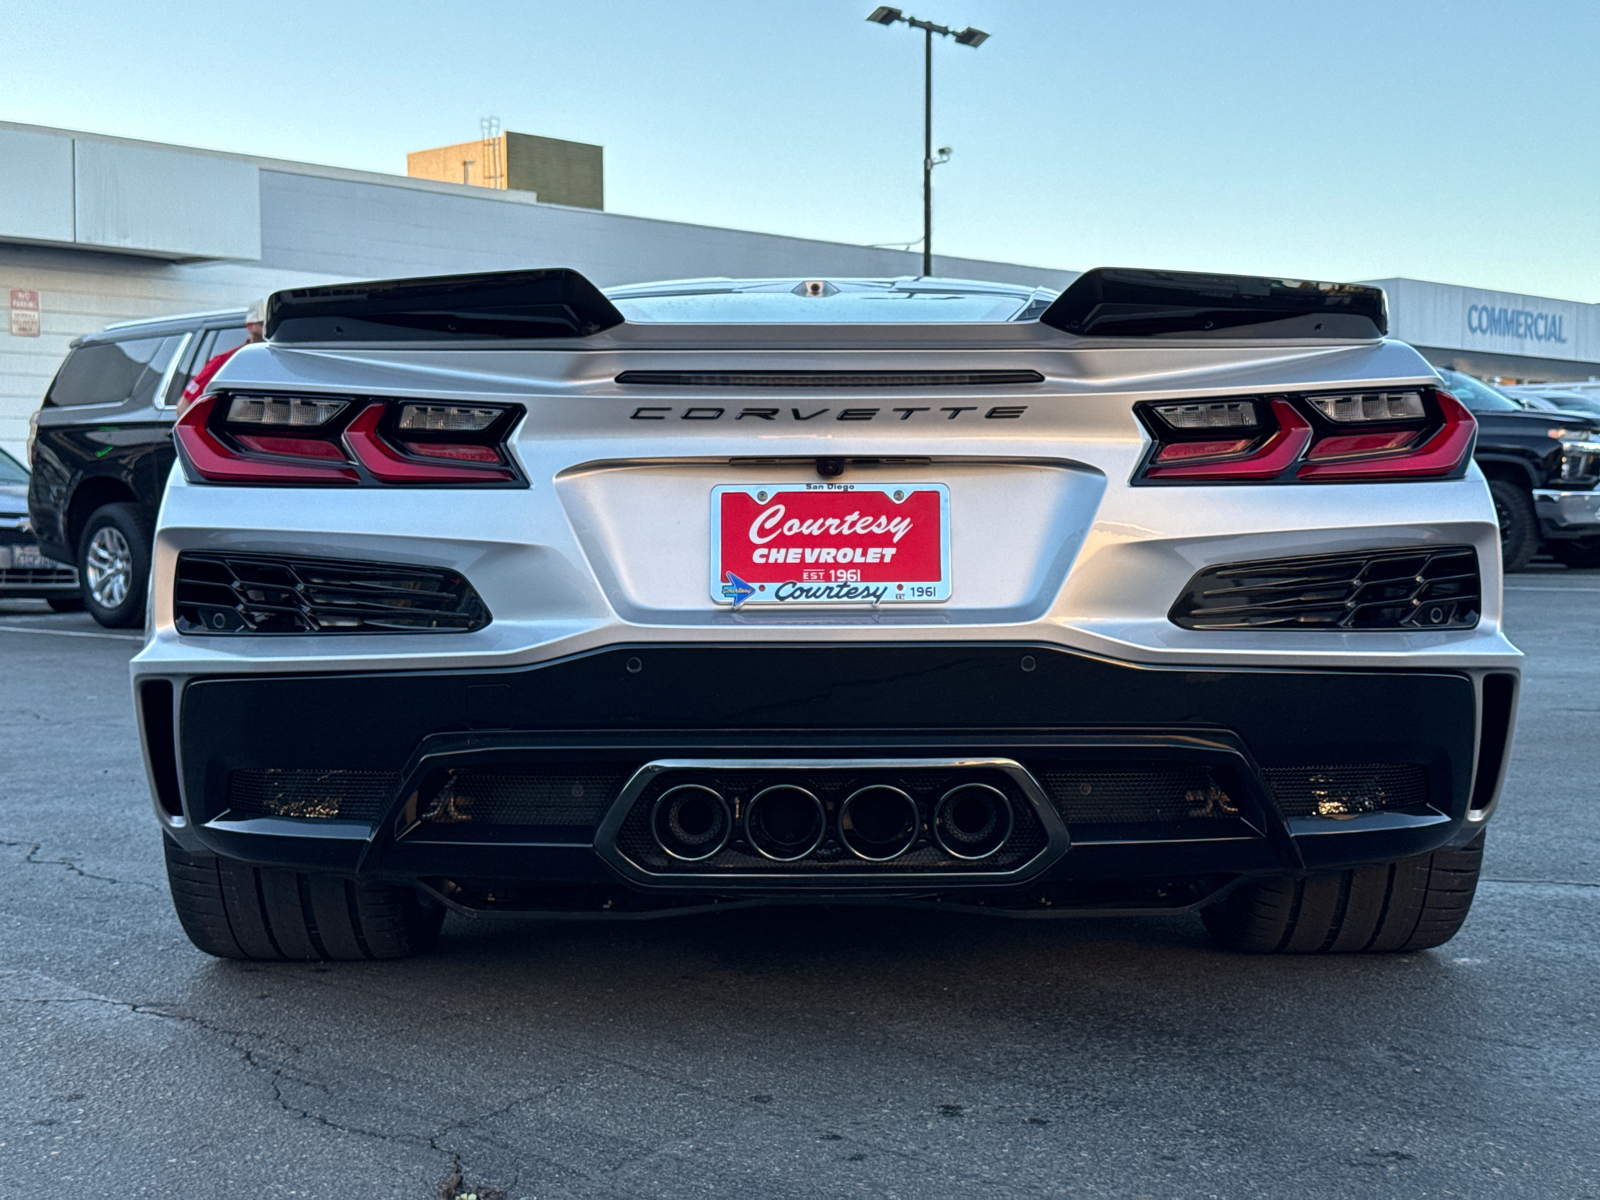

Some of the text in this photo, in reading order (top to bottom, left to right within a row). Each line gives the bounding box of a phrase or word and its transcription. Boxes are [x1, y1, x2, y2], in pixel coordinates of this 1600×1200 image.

[18, 291, 31, 301] NO
[12, 299, 38, 309] PARKING
[1467, 304, 1567, 343] COMMERCIAL
[629, 405, 1029, 421] CORVETTE
[827, 483, 855, 492] Diego
[749, 504, 914, 544] Courtesy
[752, 548, 897, 563] CHEVROLET
[803, 569, 861, 582] EST 1961
[775, 581, 888, 604] Courtesy
[910, 586, 937, 598] 1961
